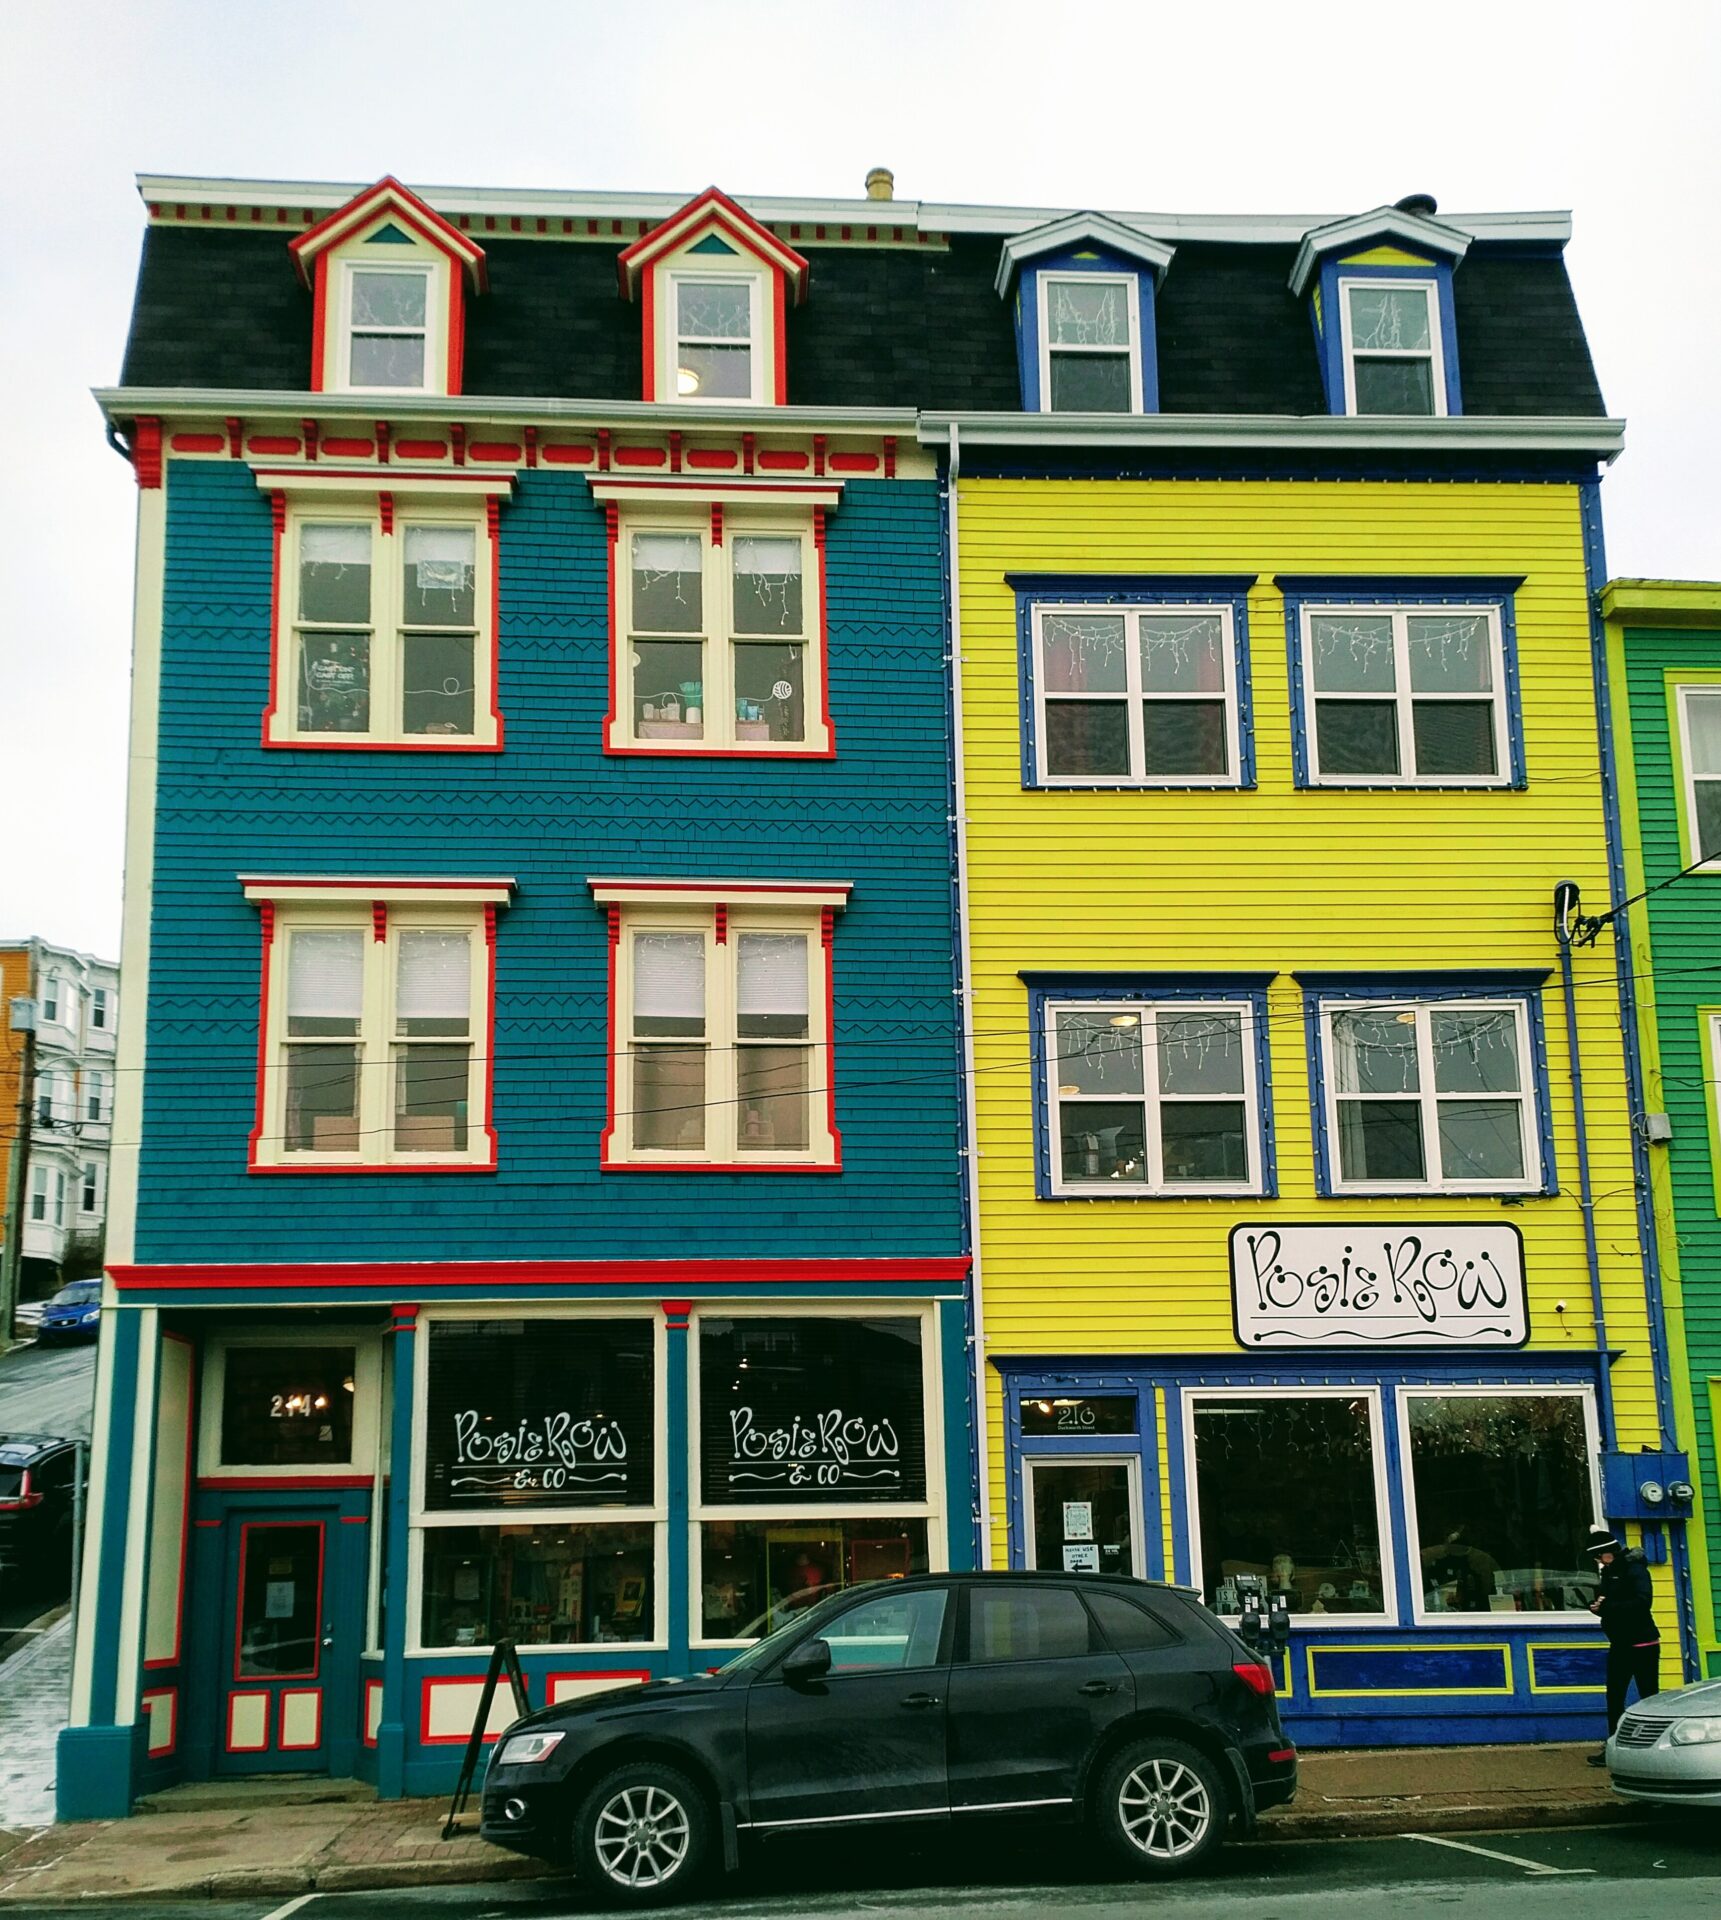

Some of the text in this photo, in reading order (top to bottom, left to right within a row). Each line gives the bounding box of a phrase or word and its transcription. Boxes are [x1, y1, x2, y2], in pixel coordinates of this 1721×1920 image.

[1247, 1231, 1379, 1313] Posie
[270, 1394, 311, 1417] 214
[454, 1410, 543, 1463] Posie
[729, 1406, 817, 1460] Posie
[513, 1468, 539, 1489] &
[789, 1465, 812, 1485] &
